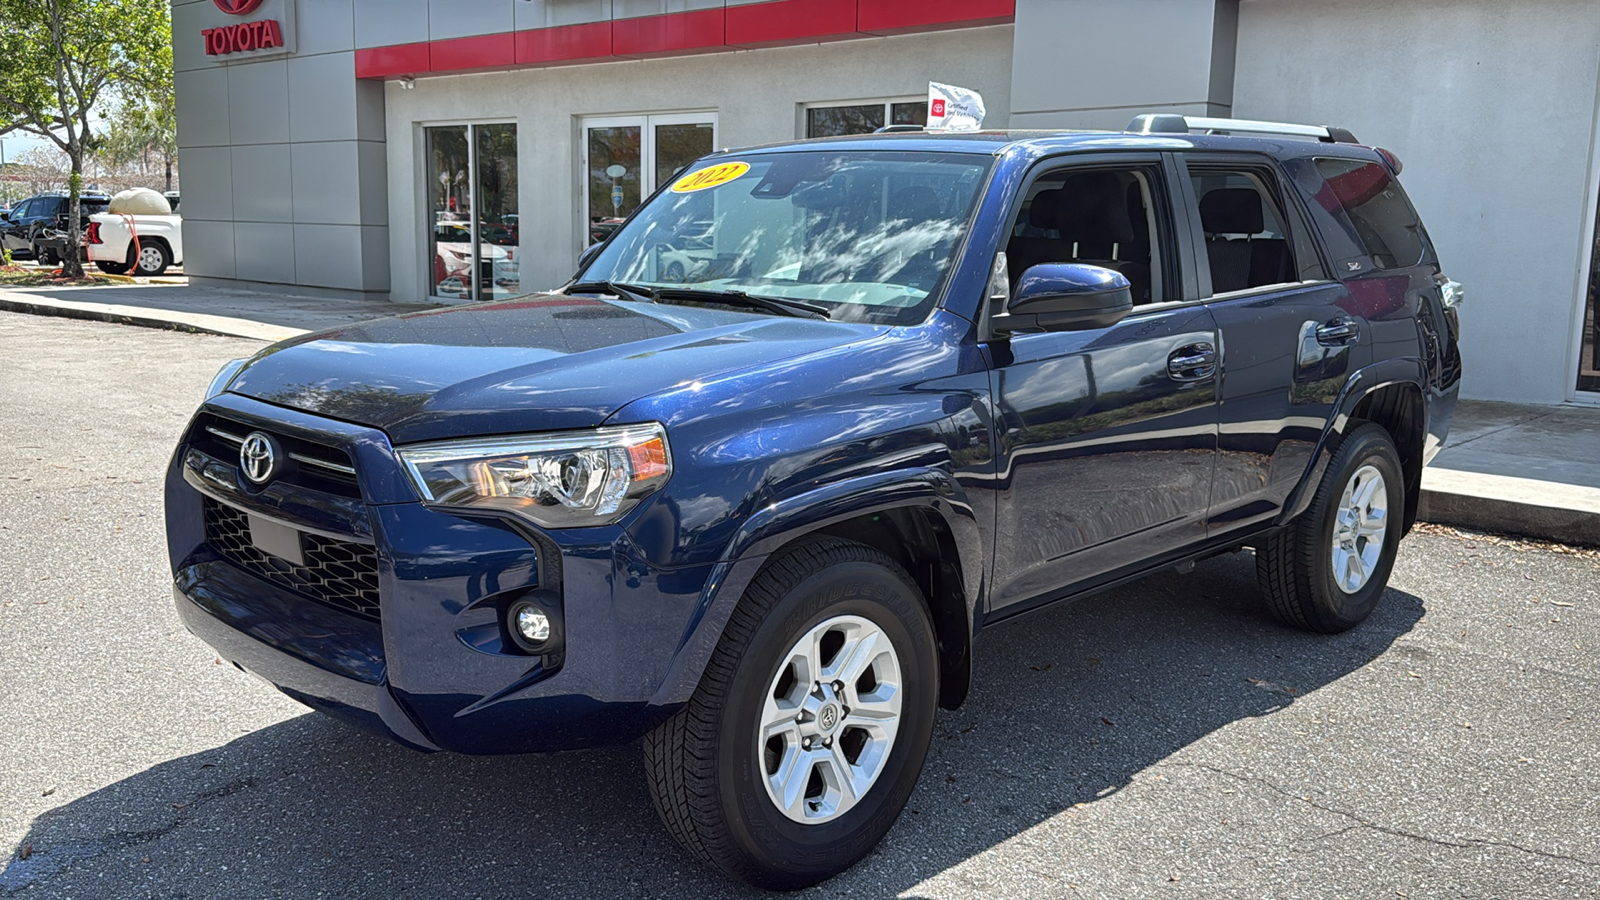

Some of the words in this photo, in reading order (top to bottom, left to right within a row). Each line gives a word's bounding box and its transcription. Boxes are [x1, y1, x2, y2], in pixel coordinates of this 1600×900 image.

[201, 19, 281, 55] TOYOTA
[680, 165, 740, 189] 2022
[784, 580, 927, 646] BRIDGESTONE
